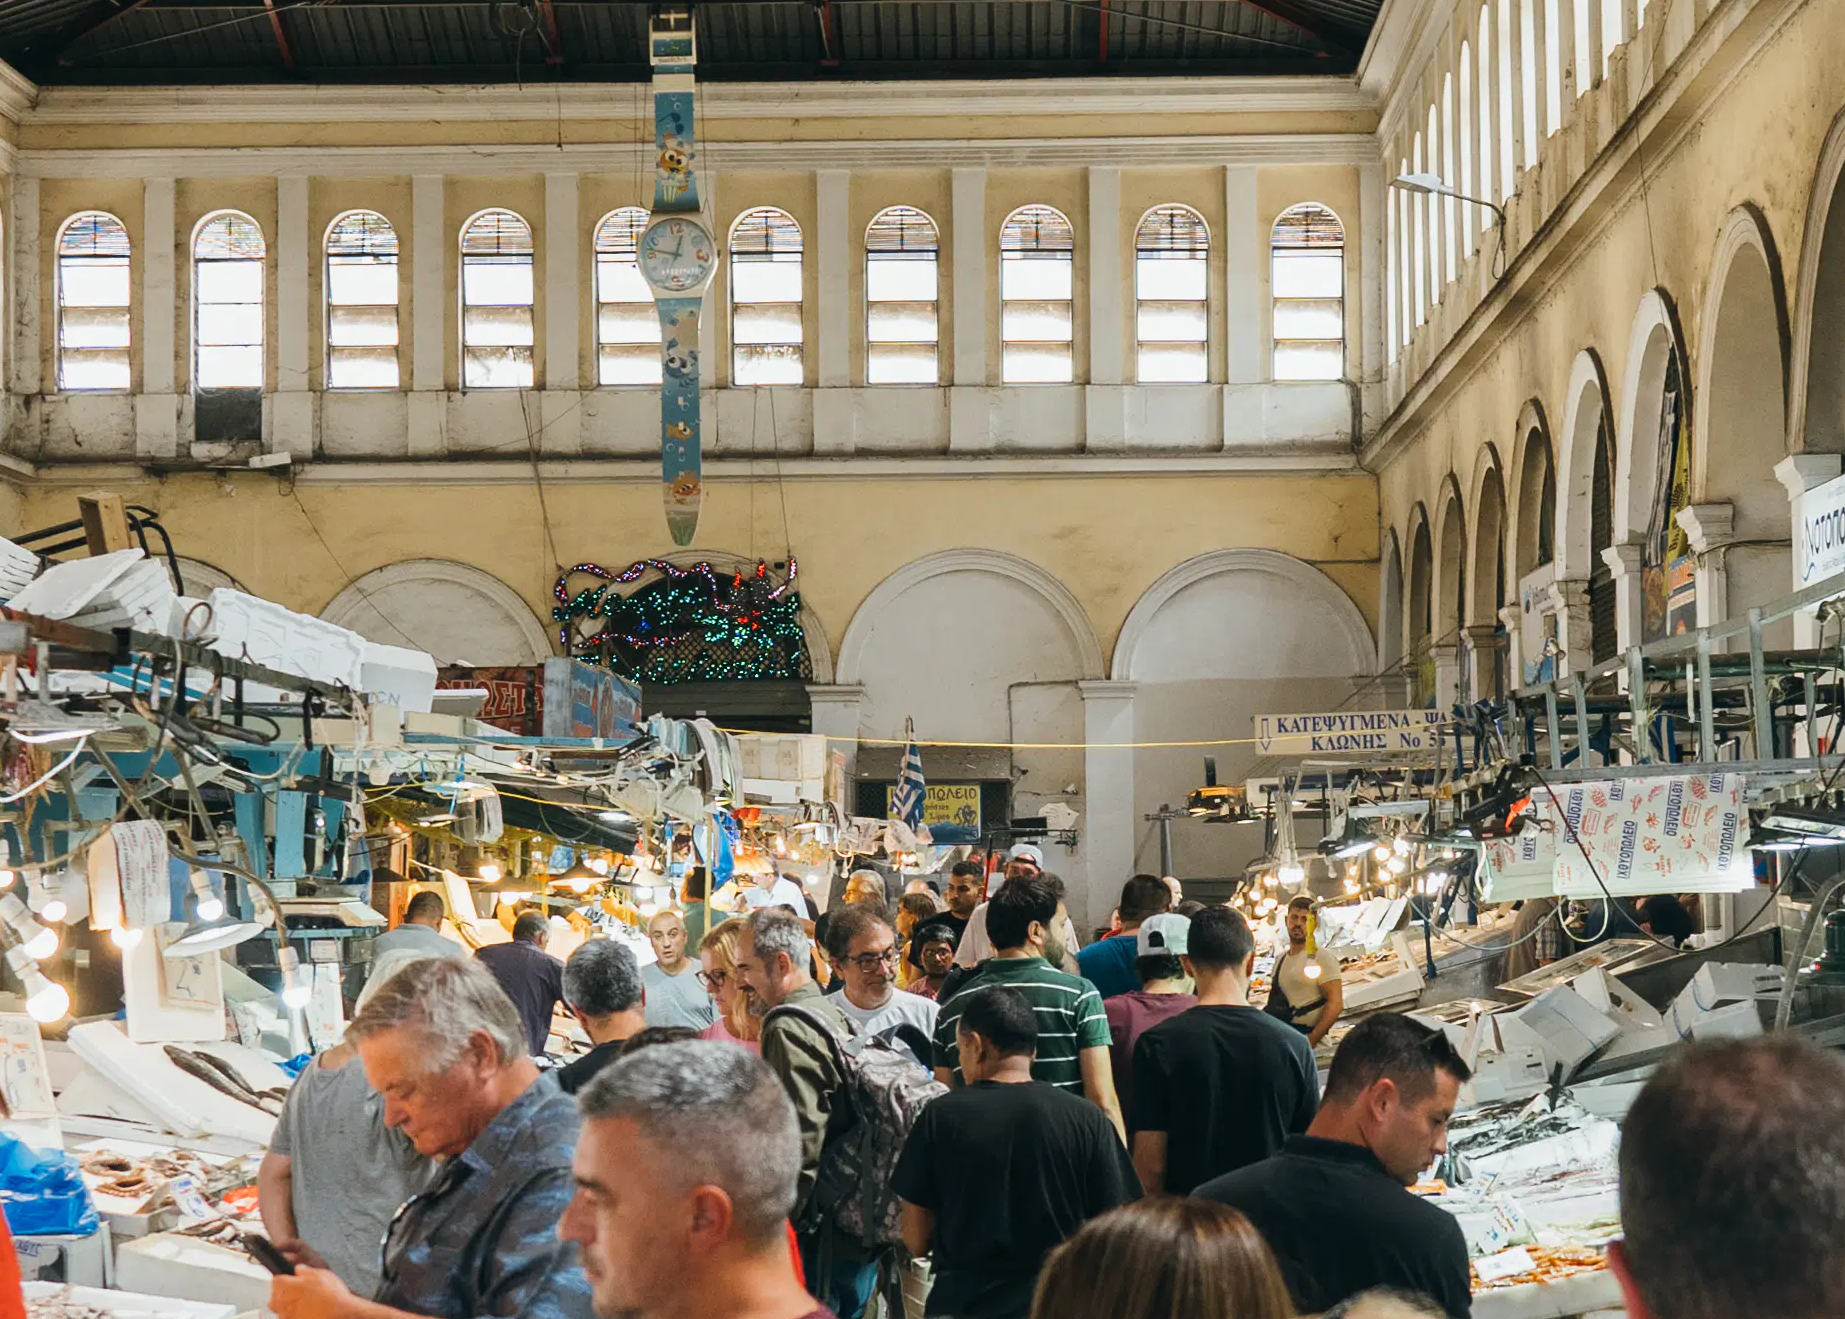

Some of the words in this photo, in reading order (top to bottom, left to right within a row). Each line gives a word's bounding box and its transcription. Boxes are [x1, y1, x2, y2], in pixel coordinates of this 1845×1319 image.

[1277, 714, 1410, 733] ΚΑΤΕΨΥΓΜΕΝΑ
[1312, 733, 1387, 751] ΚΛΩΝΗΣ
[1617, 820, 1636, 879] ΙΧΘΥΟΠΩΛΕΙΟ
